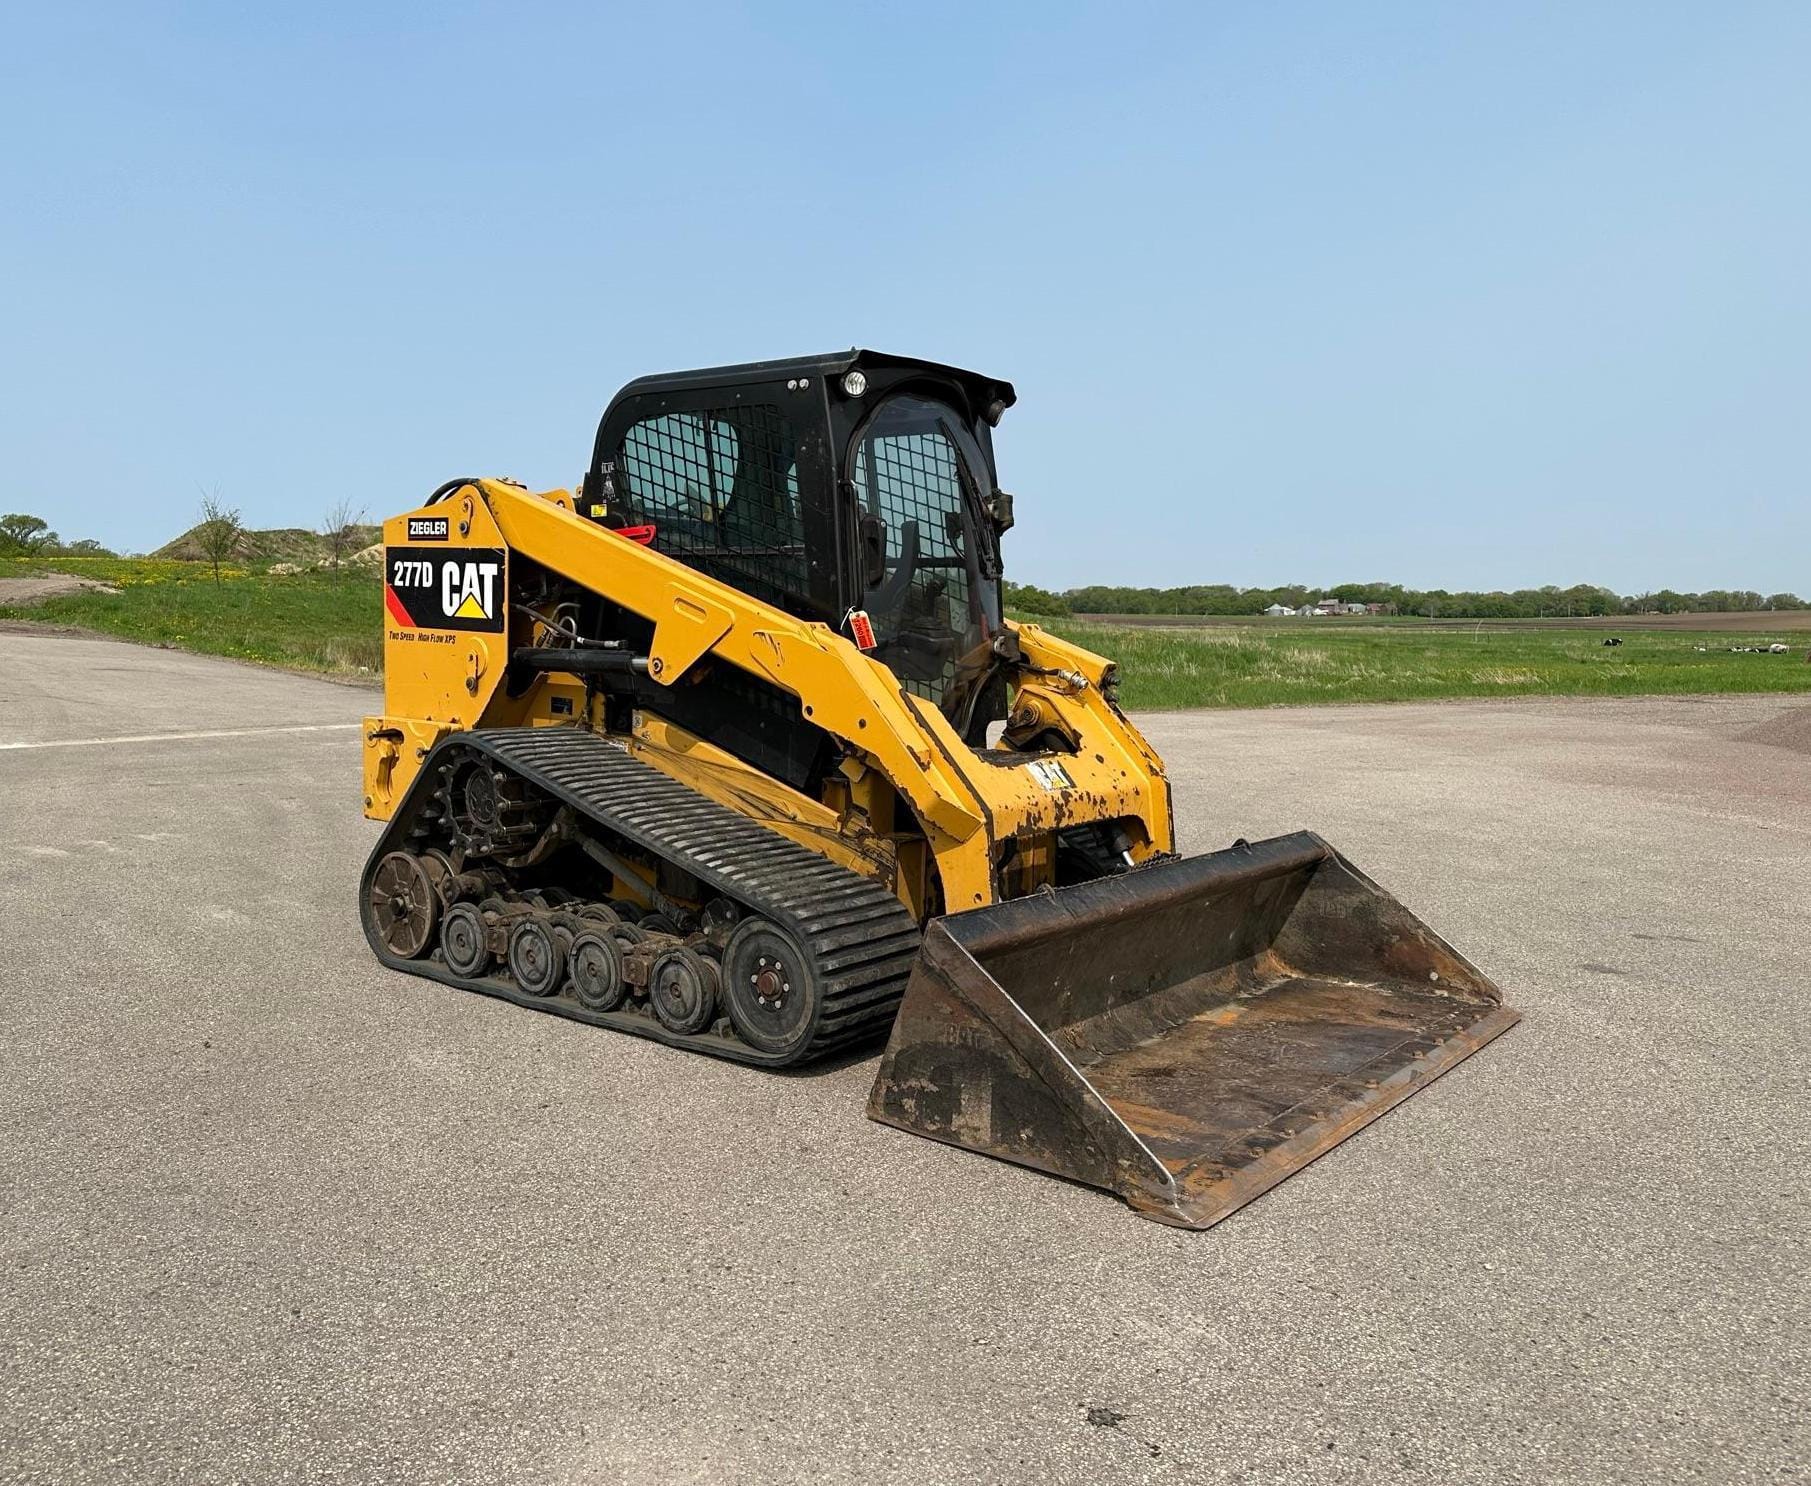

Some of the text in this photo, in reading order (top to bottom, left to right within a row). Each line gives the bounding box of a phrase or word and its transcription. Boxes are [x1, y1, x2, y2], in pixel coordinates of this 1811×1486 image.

[410, 521, 446, 534] ZIEGLER
[394, 561, 432, 587] 277D
[442, 561, 497, 619] CAT
[444, 635, 456, 644] XPS
